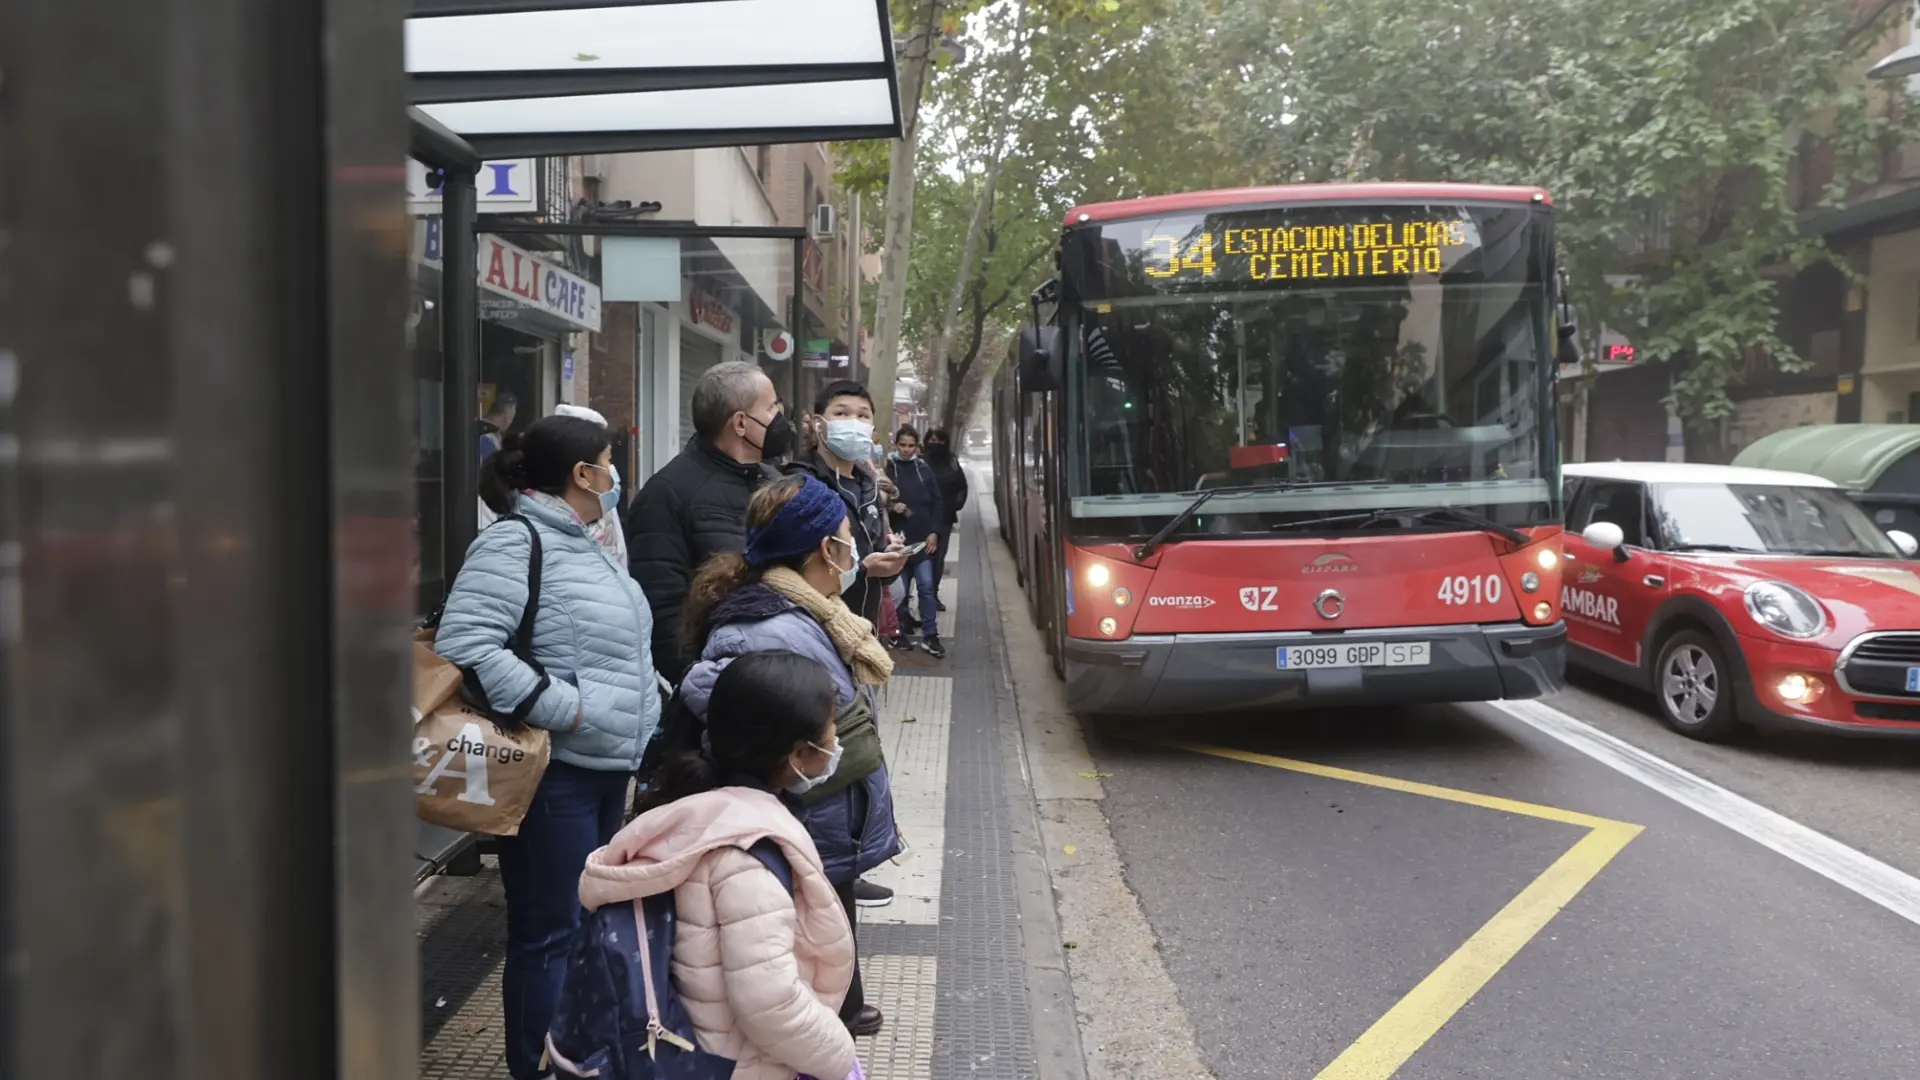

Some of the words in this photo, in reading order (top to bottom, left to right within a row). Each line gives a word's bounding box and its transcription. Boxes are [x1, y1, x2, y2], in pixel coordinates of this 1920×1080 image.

[1143, 233, 1216, 278] 34
[1224, 225, 1345, 254] ESTACION
[1353, 219, 1466, 248] DELICIAS
[1250, 247, 1441, 280] CEMENTERIO
[485, 239, 541, 303] ALI
[544, 270, 586, 320] CAFE
[1149, 595, 1202, 606] avanza
[1260, 586, 1279, 612] Z
[1437, 574, 1502, 605] 4910
[1560, 585, 1620, 626] AMBAR
[1292, 648, 1337, 666] 3099
[446, 734, 525, 765] change
